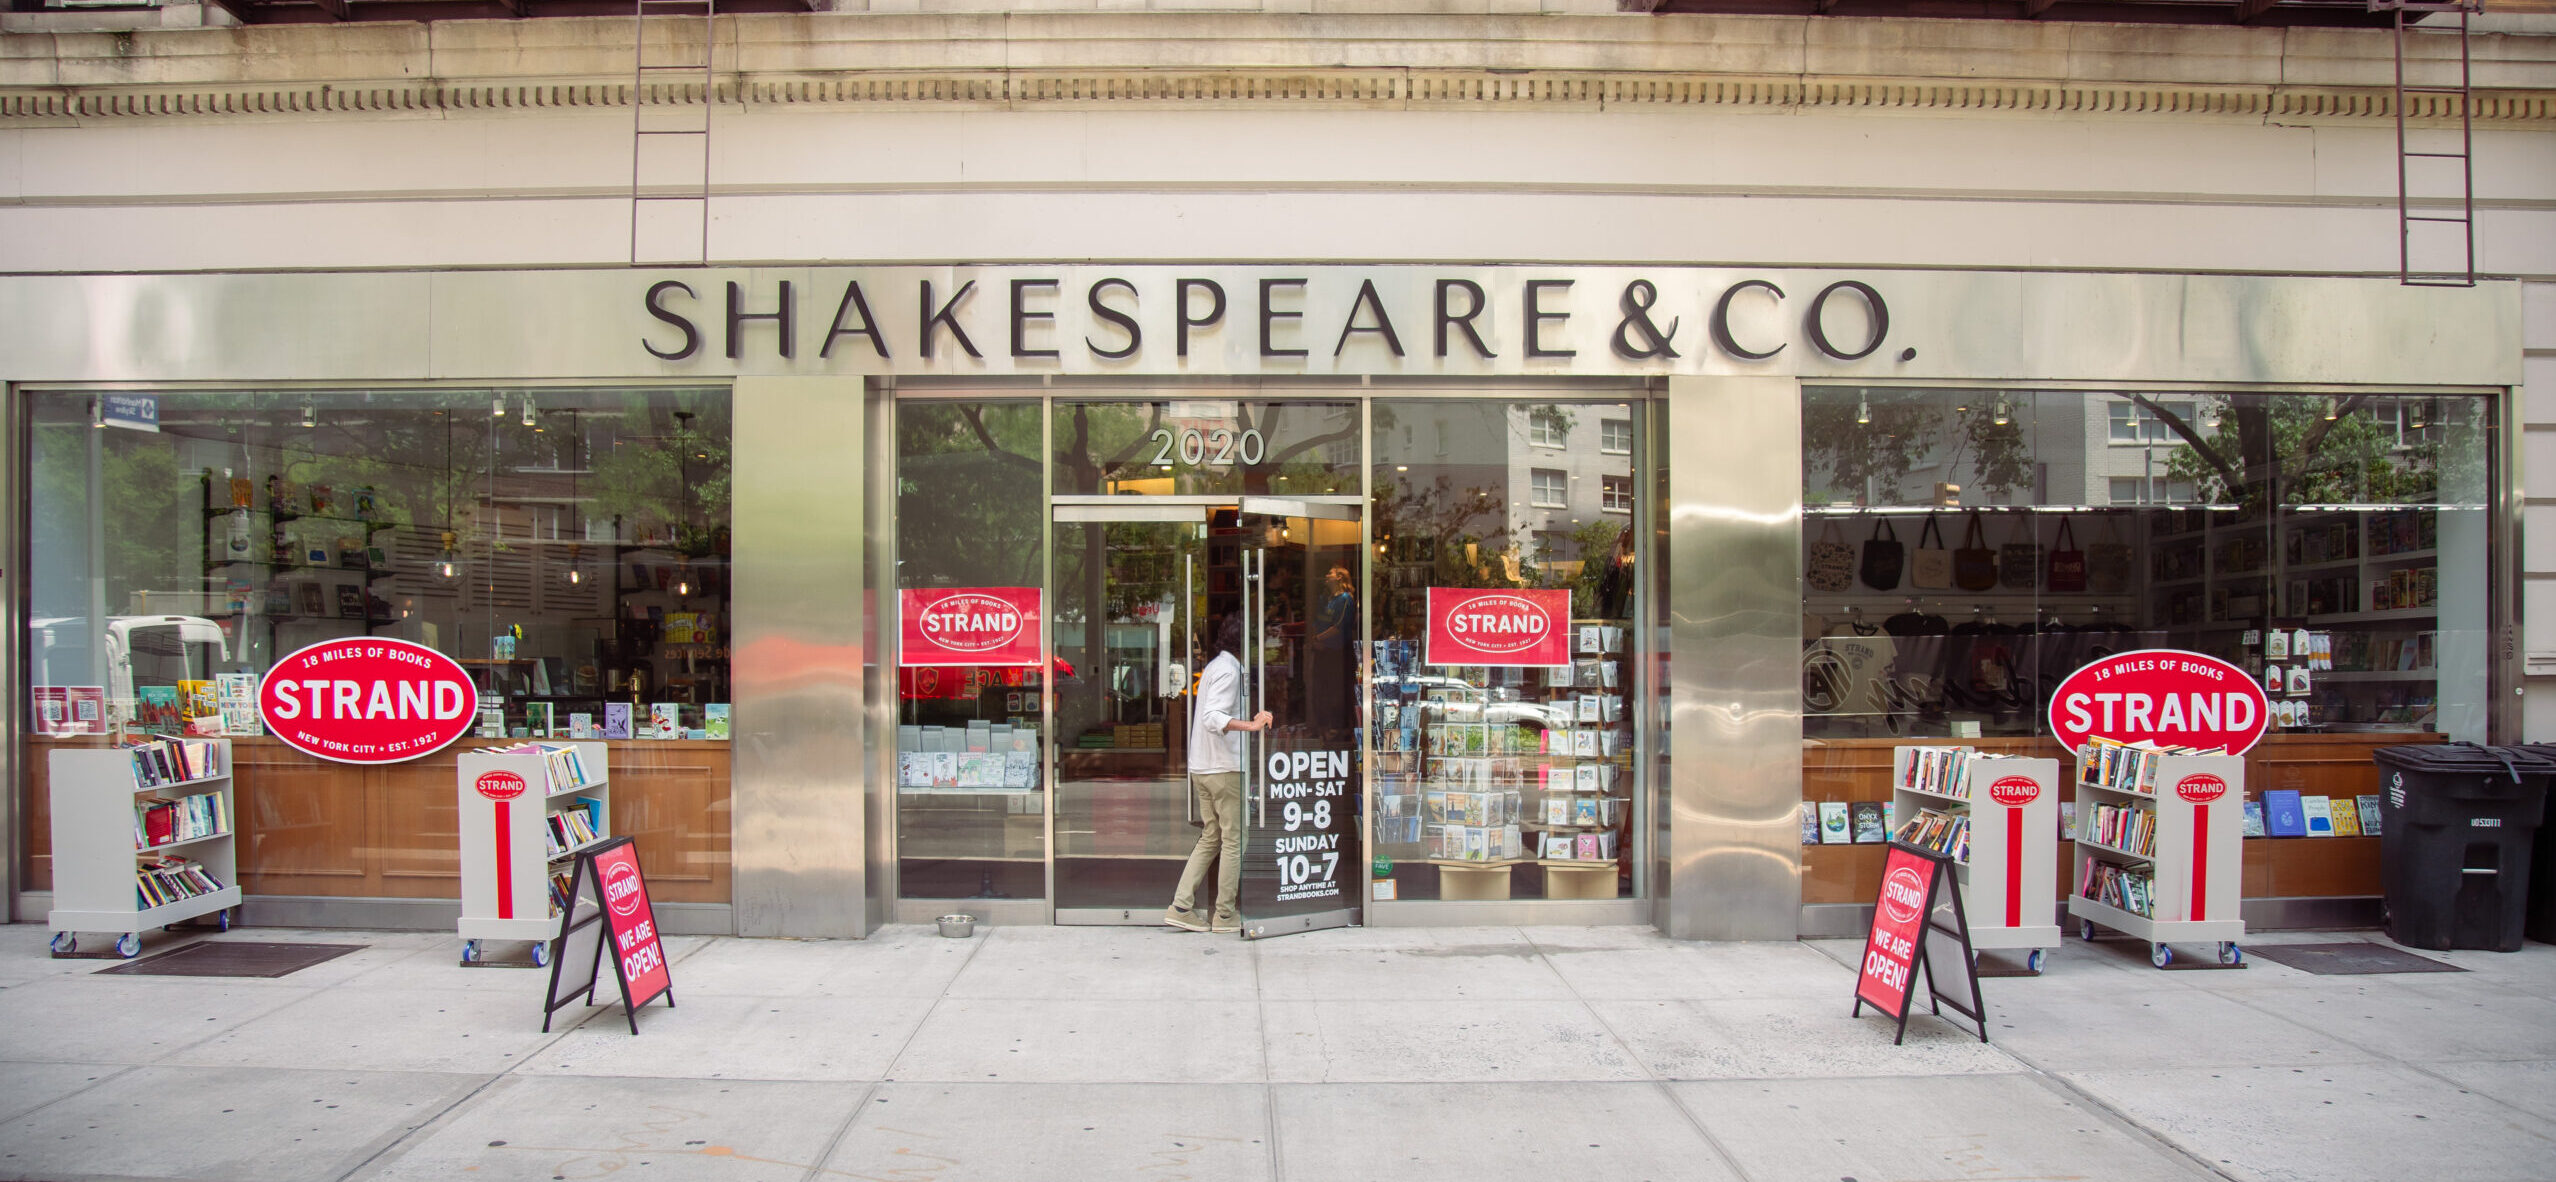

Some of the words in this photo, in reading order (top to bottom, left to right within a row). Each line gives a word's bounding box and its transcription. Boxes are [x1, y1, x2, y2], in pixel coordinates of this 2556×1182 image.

[1149, 428, 1265, 466] 2020
[950, 599, 969, 607] MILES
[981, 599, 1001, 609] BOOKS
[1478, 599, 1498, 608] MILES
[1509, 600, 1530, 611] BOOKS
[927, 613, 1017, 633] STRAND
[1453, 613, 1544, 634] STRAND
[950, 639, 963, 647] YORK
[1844, 643, 1874, 659] STRAND
[302, 654, 319, 669] 18
[323, 647, 362, 662] MILES
[367, 647, 384, 658] OF
[389, 648, 433, 669] BOOKS
[2093, 669, 2111, 682] 18
[2115, 660, 2155, 675] MILES
[2159, 659, 2177, 670] OF
[2181, 661, 2224, 681] BOOKS
[273, 679, 465, 721] STRAND
[2064, 692, 2256, 734] STRAND
[297, 730, 320, 746] NEW
[323, 739, 350, 752] YORK
[353, 744, 376, 754] CITY
[389, 740, 411, 752] EST.
[414, 731, 438, 747] 1927
[1268, 750, 1349, 780] OPEN
[479, 780, 524, 791] STRAND
[1993, 785, 2038, 796] STRAND
[2179, 783, 2224, 794] STRAND
[1283, 799, 1332, 832] 9-8
[1275, 834, 1340, 854] SUNDAY
[1276, 852, 1340, 886] 10-7
[607, 875, 639, 903] STRAND
[1277, 889, 1340, 901] STRANDBOOKS.COM
[1280, 885, 1298, 893] SHOP
[1299, 882, 1327, 891] ANYTIME
[1886, 881, 1921, 909] STRAND
[618, 929, 636, 951] WE
[635, 920, 653, 943] ARE
[1874, 927, 1892, 950] WE
[1890, 936, 1912, 960] ARE
[624, 941, 662, 982] OPEN!
[1866, 950, 1909, 993] OPEN!
